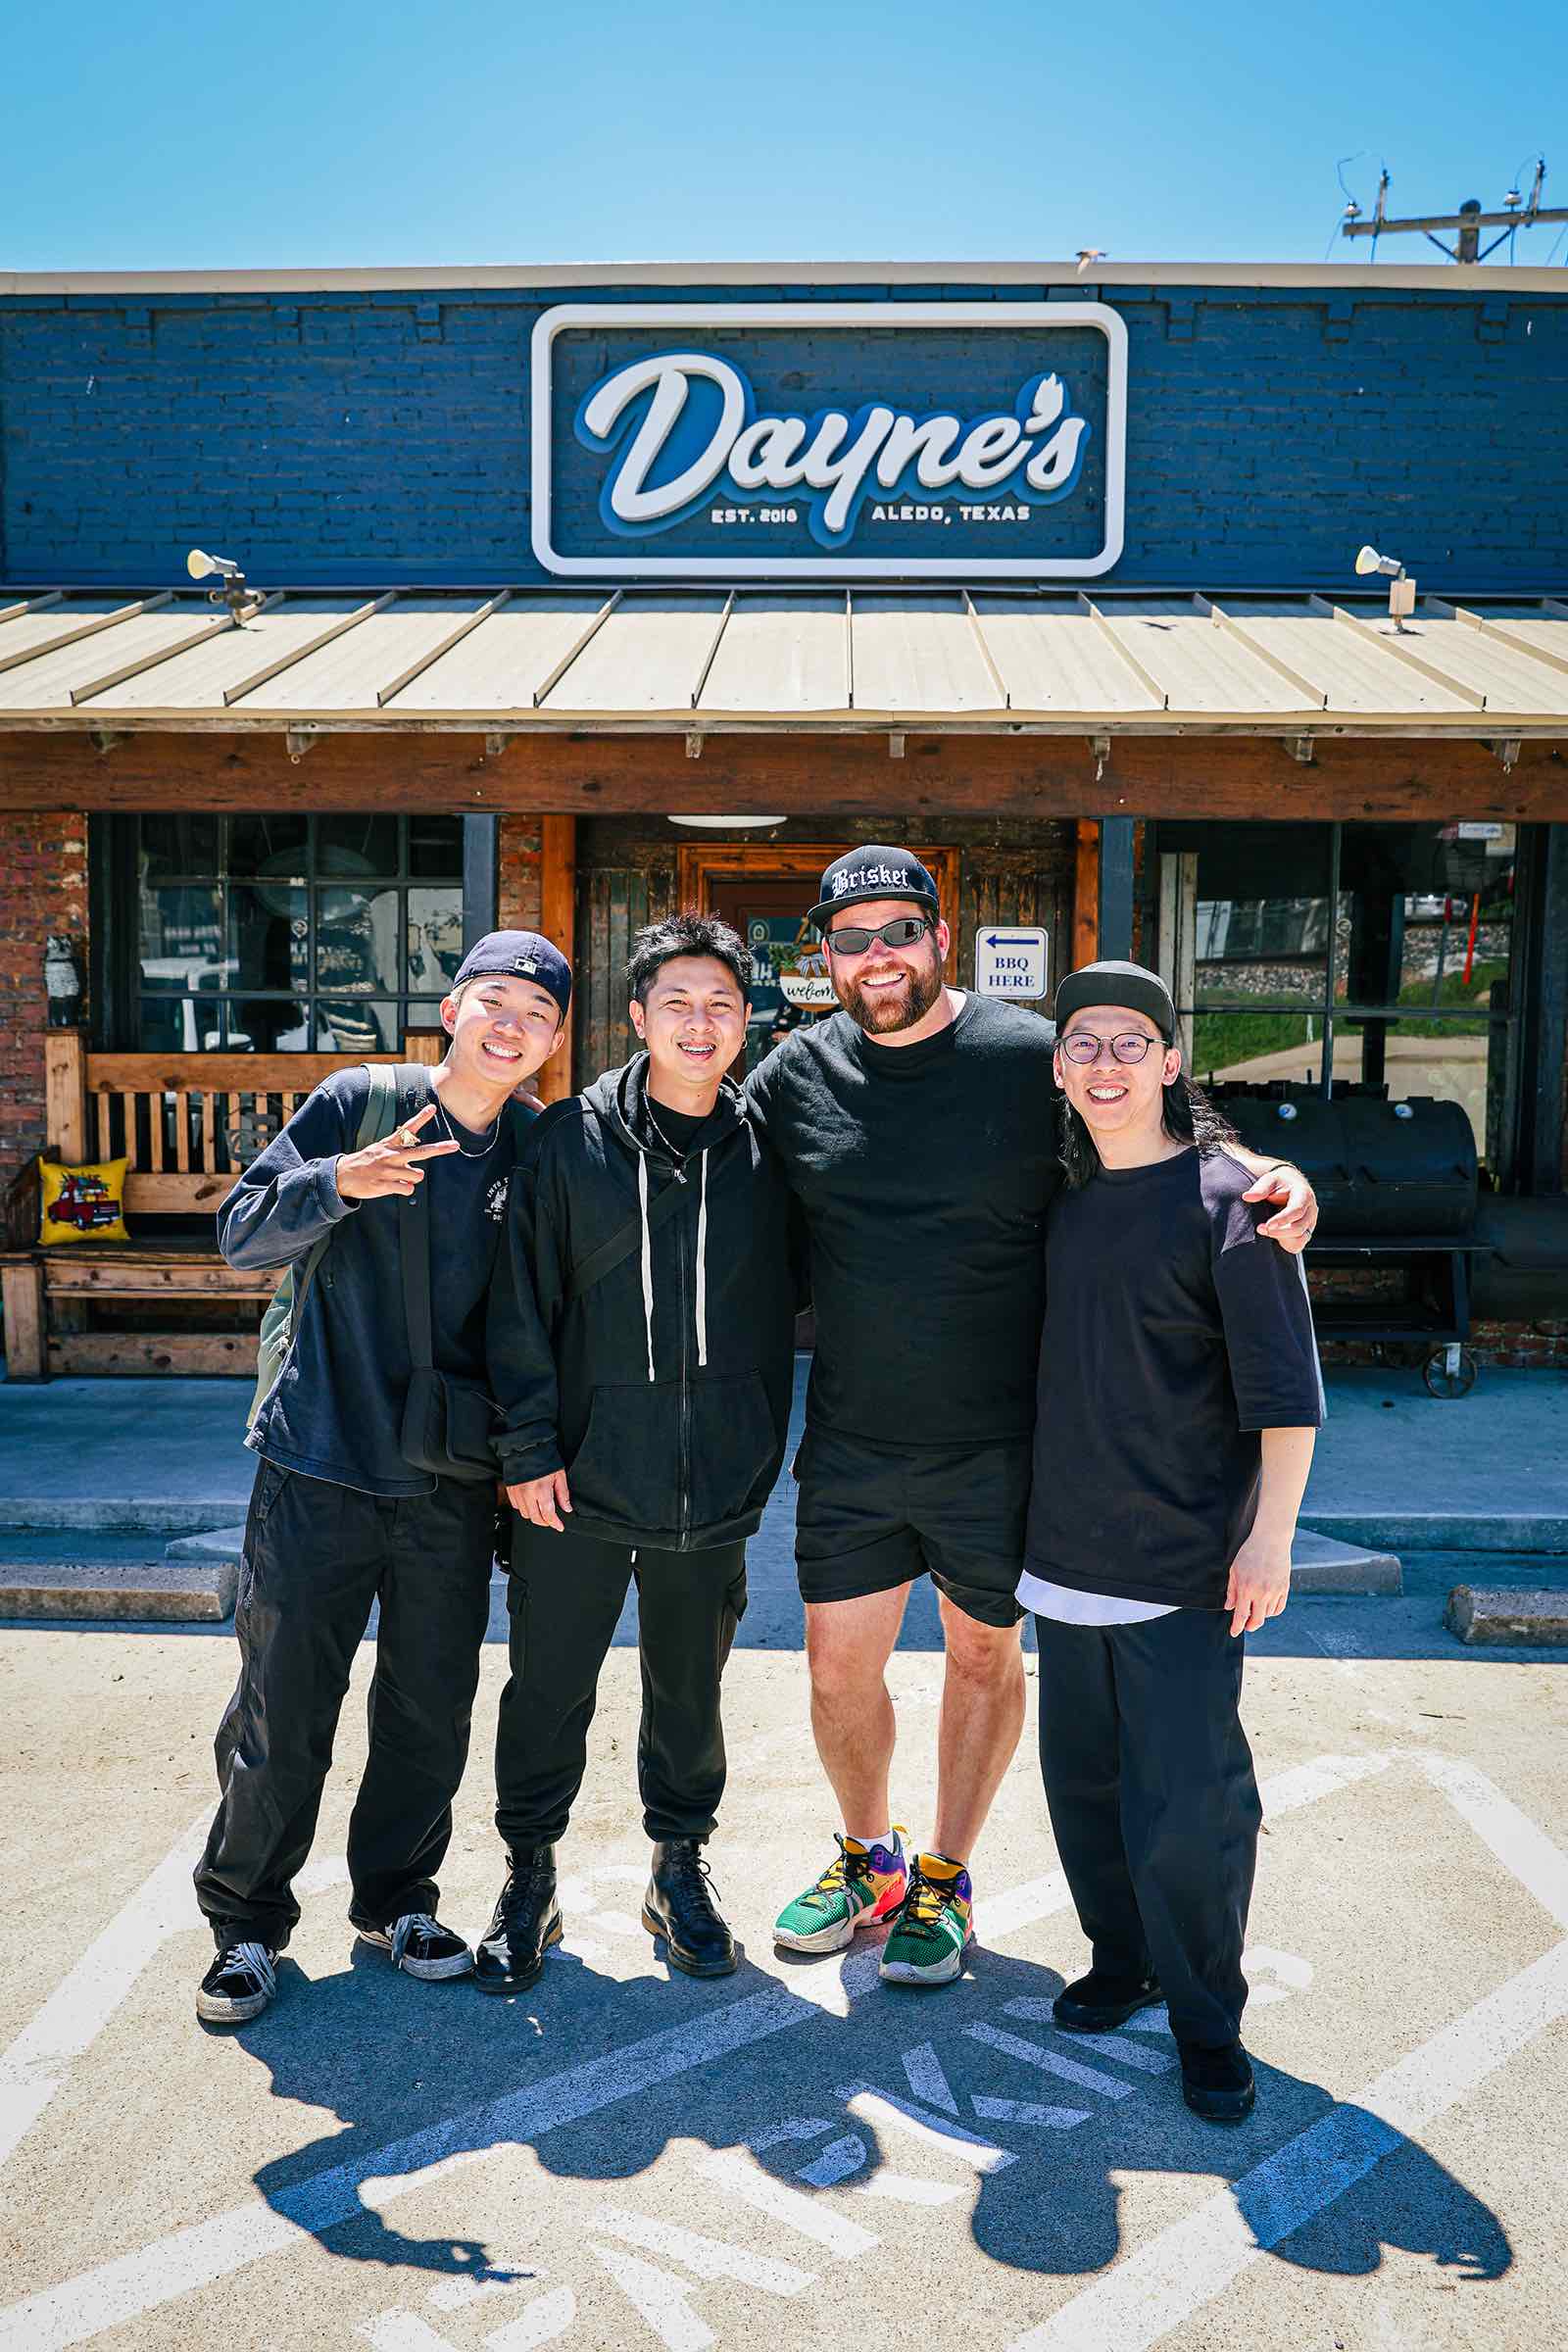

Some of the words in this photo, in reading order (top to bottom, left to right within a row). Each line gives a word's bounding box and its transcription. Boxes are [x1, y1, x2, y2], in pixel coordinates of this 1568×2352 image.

[583, 353, 1086, 533] Dayne's
[710, 508, 756, 523] EST.
[871, 505, 952, 525] ALEDO,
[958, 505, 1030, 521] TEXAS
[831, 863, 909, 900] Brisket
[995, 956, 1029, 972] BBQ
[787, 981, 836, 1001] welcom
[988, 974, 1036, 988] HERE
